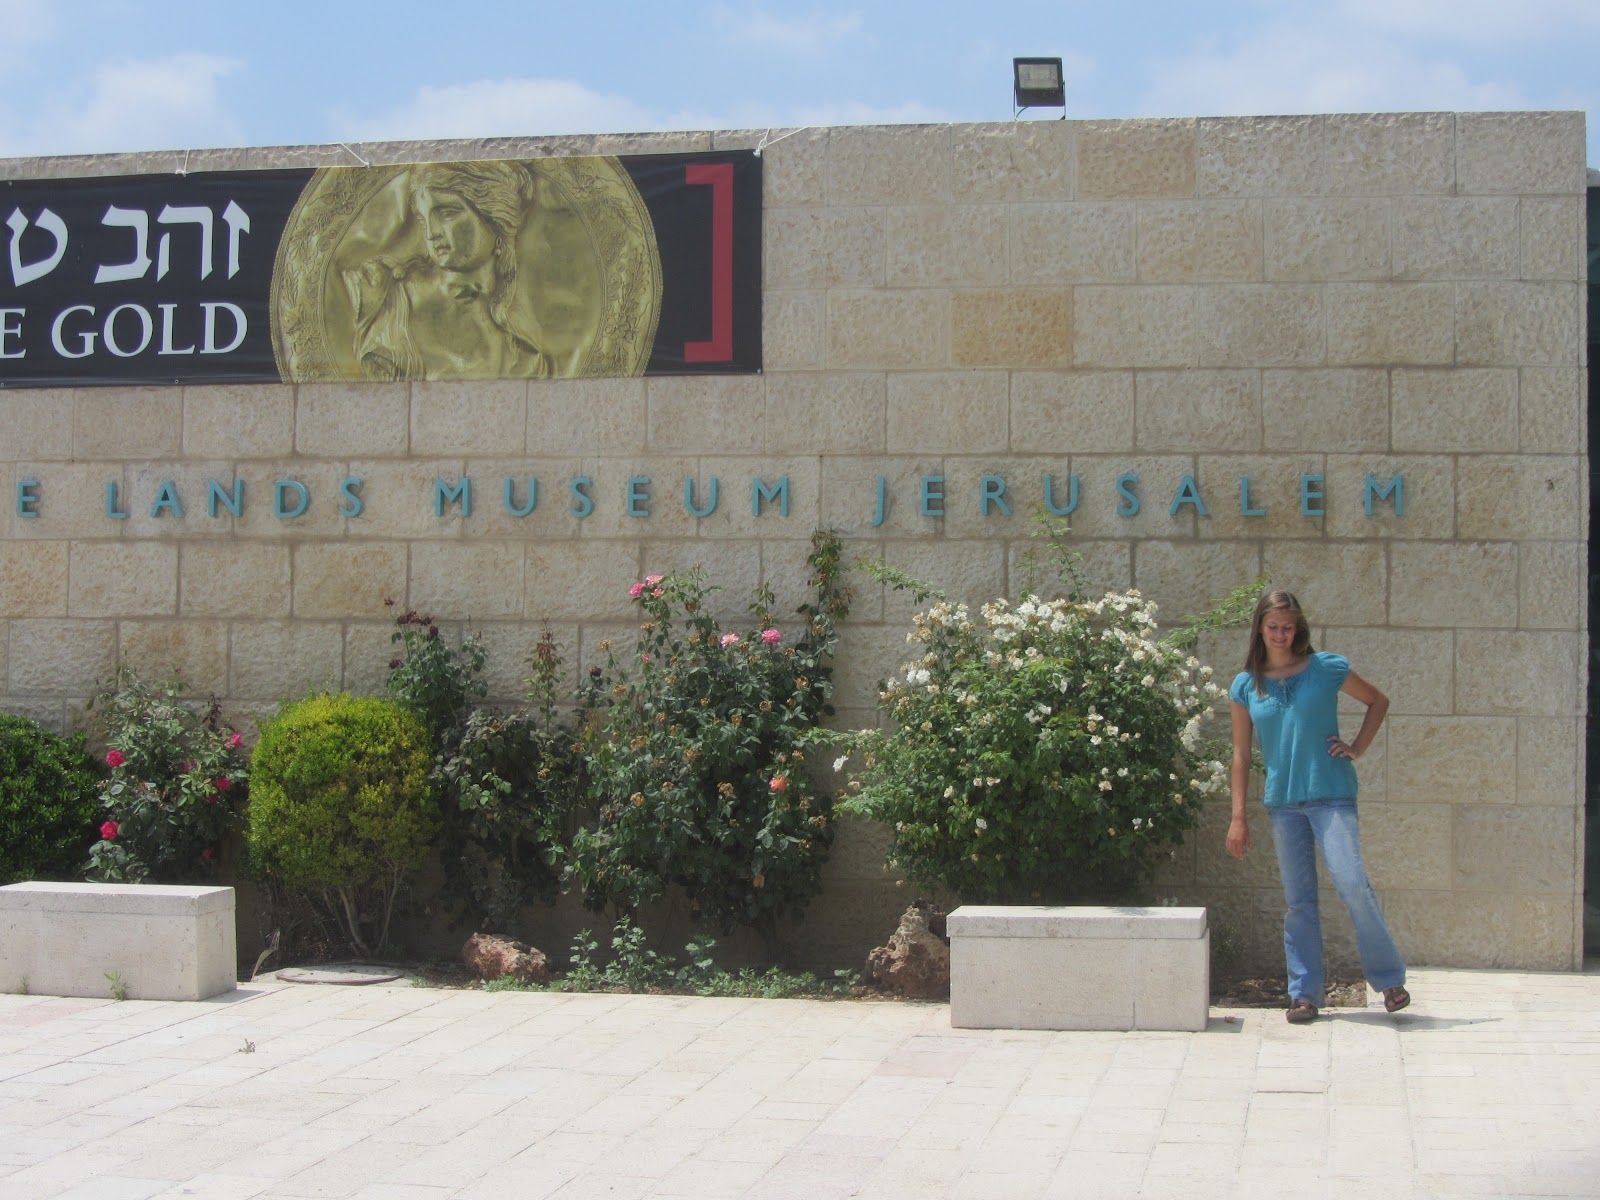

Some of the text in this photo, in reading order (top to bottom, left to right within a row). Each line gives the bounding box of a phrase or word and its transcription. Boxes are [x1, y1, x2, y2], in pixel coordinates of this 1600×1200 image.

[93, 199, 251, 284] זהב
[51, 302, 249, 359] GOLD
[105, 476, 364, 519] LANDS
[433, 475, 790, 518] MUSEUM
[870, 472, 1405, 527] JERUSALEM
